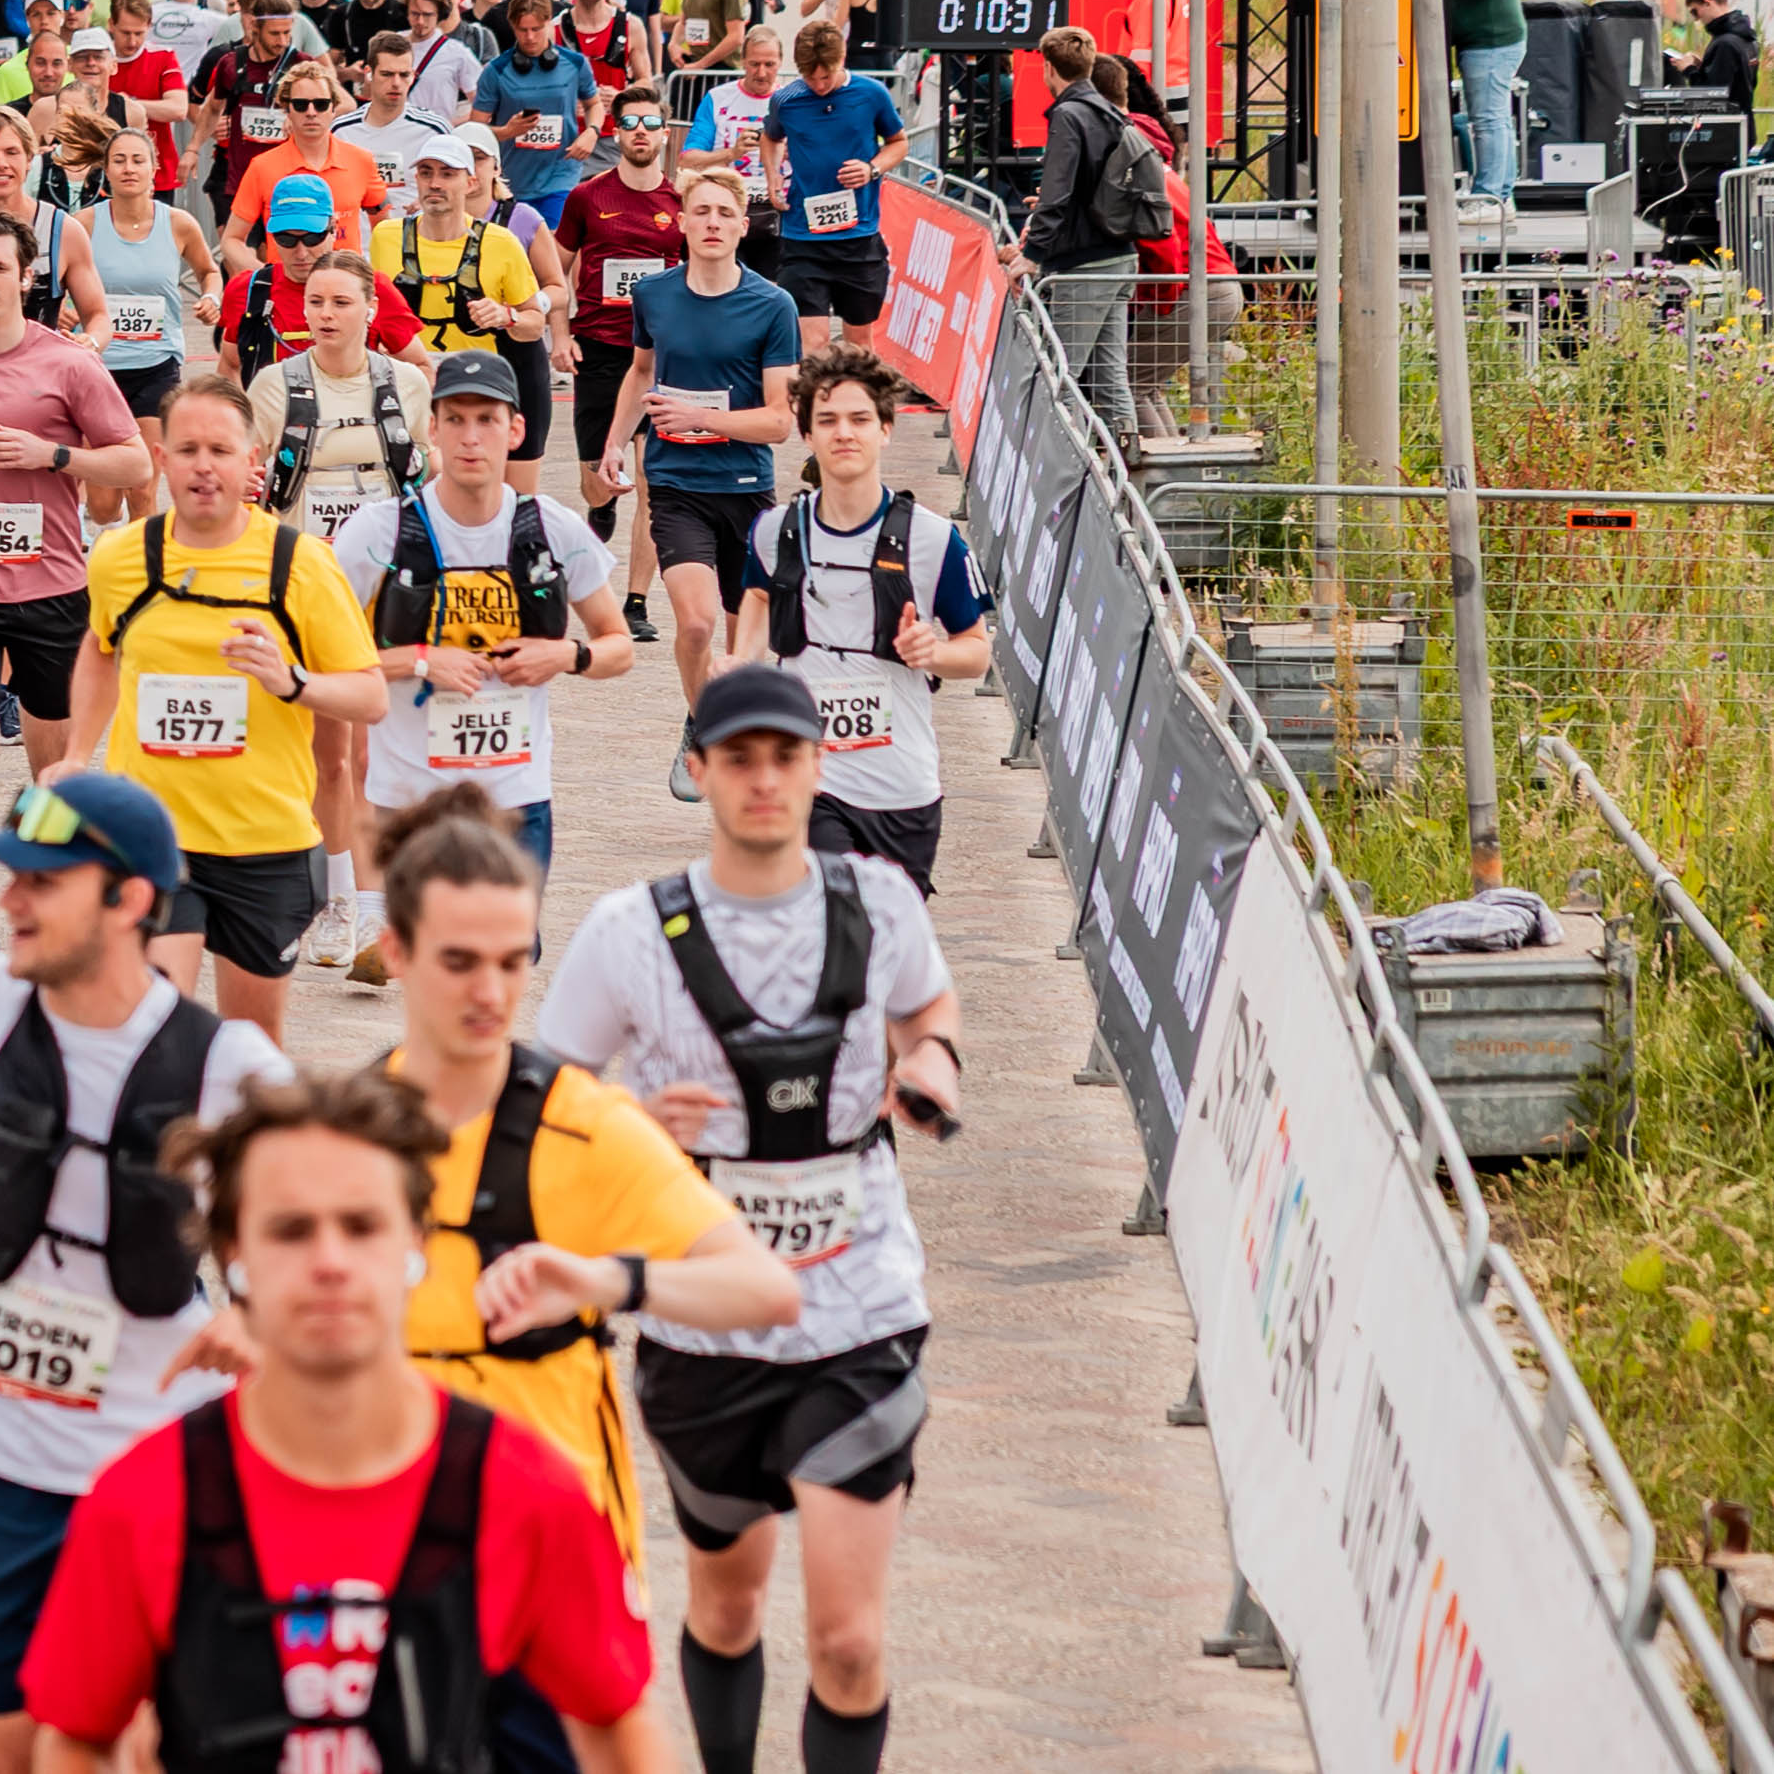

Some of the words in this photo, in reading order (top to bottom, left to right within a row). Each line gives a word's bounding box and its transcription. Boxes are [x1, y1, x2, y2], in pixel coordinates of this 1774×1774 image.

[248, 125, 282, 137] 3397
[120, 308, 146, 317] LUC
[112, 318, 153, 332] 1387
[434, 586, 514, 610] TRECH
[166, 698, 213, 716] BAS
[451, 710, 512, 729] JELLE
[156, 718, 225, 742] 1577
[453, 729, 508, 756] 170
[733, 1189, 845, 1216] ARTHUR
